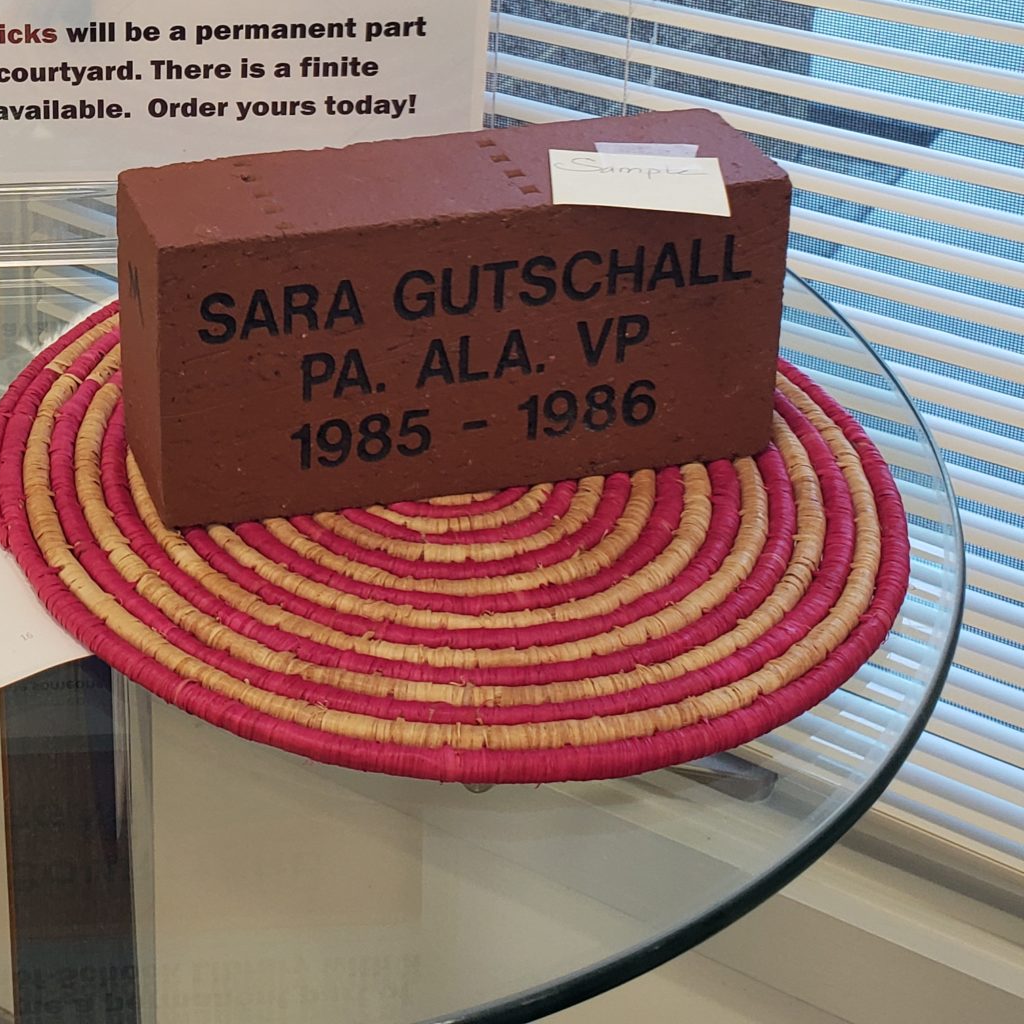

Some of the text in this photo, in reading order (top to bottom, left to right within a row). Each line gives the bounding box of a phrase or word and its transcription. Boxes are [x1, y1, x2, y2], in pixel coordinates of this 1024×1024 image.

[65, 21, 115, 43] will
[125, 21, 160, 42] be
[168, 25, 186, 41] a
[195, 17, 356, 45] permanent
[365, 16, 427, 42] part
[150, 59, 231, 80] There
[240, 57, 265, 78] is
[273, 62, 291, 78] a
[299, 56, 378, 77] finite
[147, 97, 228, 118] Order
[235, 100, 316, 121] yours
[324, 94, 416, 119] today!
[553, 157, 708, 180] Sample
[198, 233, 752, 345] SARA GUTSCHALL
[301, 314, 651, 402] PA. ALA. VP
[289, 408, 432, 470] 1985
[517, 379, 657, 441] 1986
